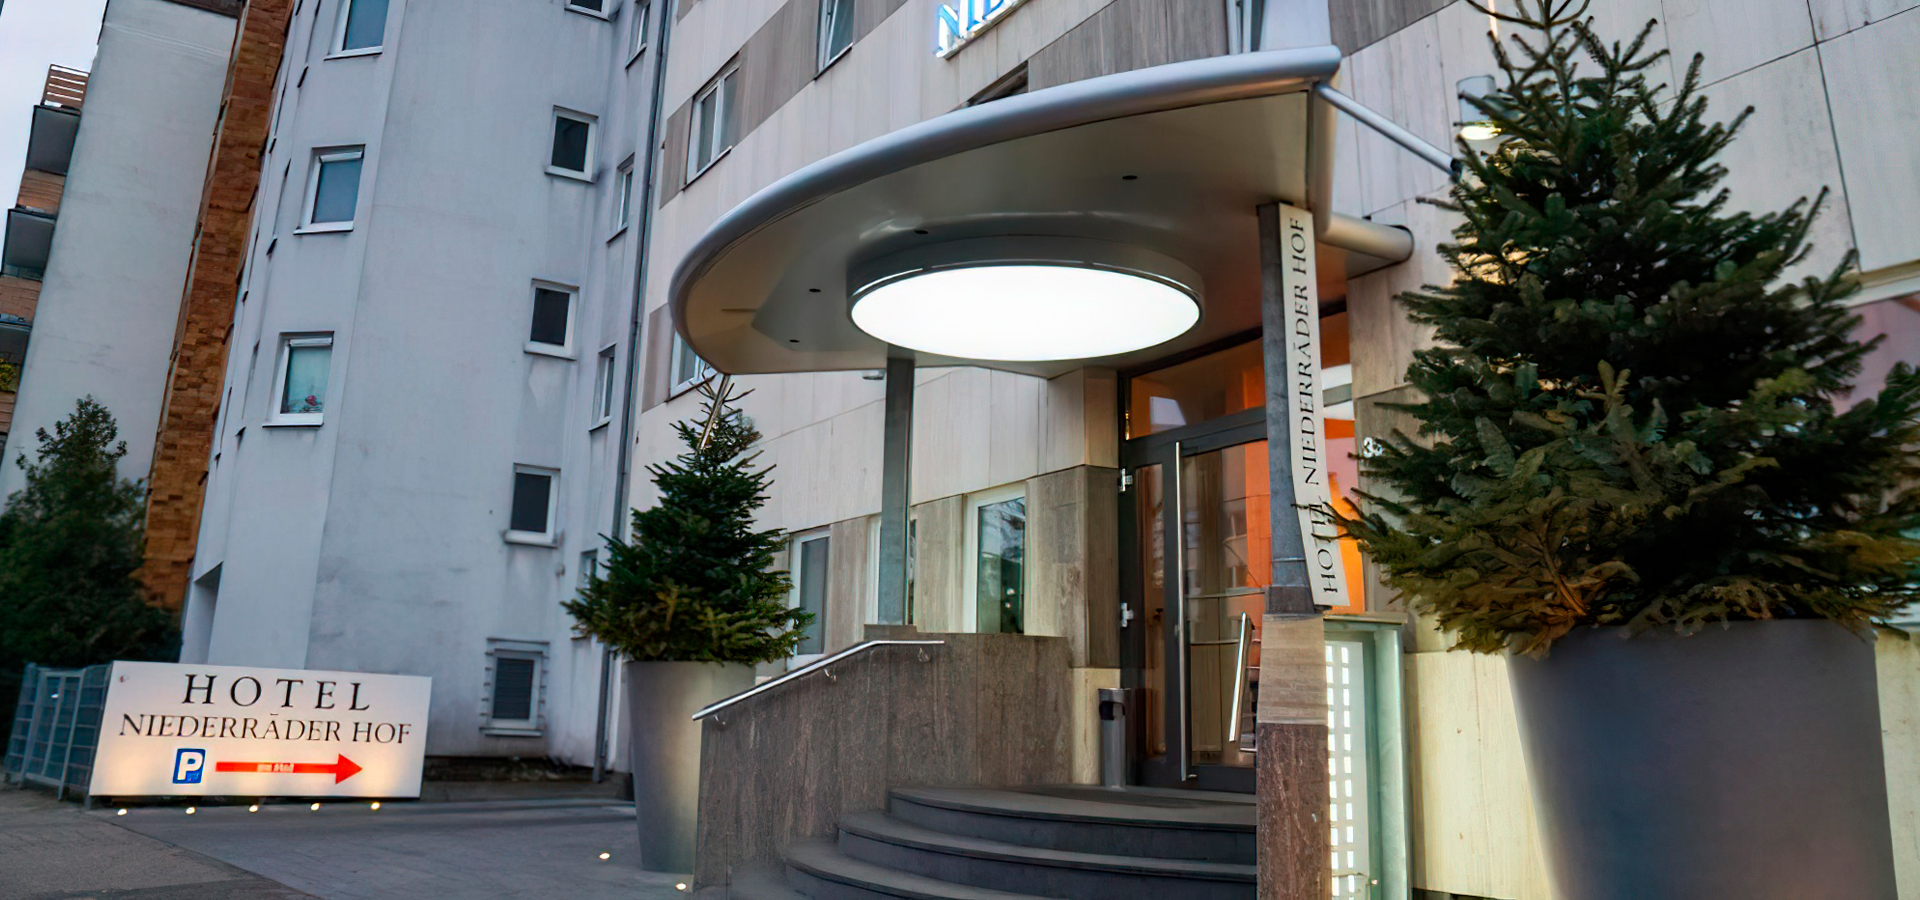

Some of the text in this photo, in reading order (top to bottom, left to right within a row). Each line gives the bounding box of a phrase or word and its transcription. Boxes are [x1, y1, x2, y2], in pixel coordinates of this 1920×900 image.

[1289, 217, 1307, 274] HOF
[181, 674, 370, 711] HOTEL
[352, 721, 412, 744] HOF
[177, 751, 203, 780] P
